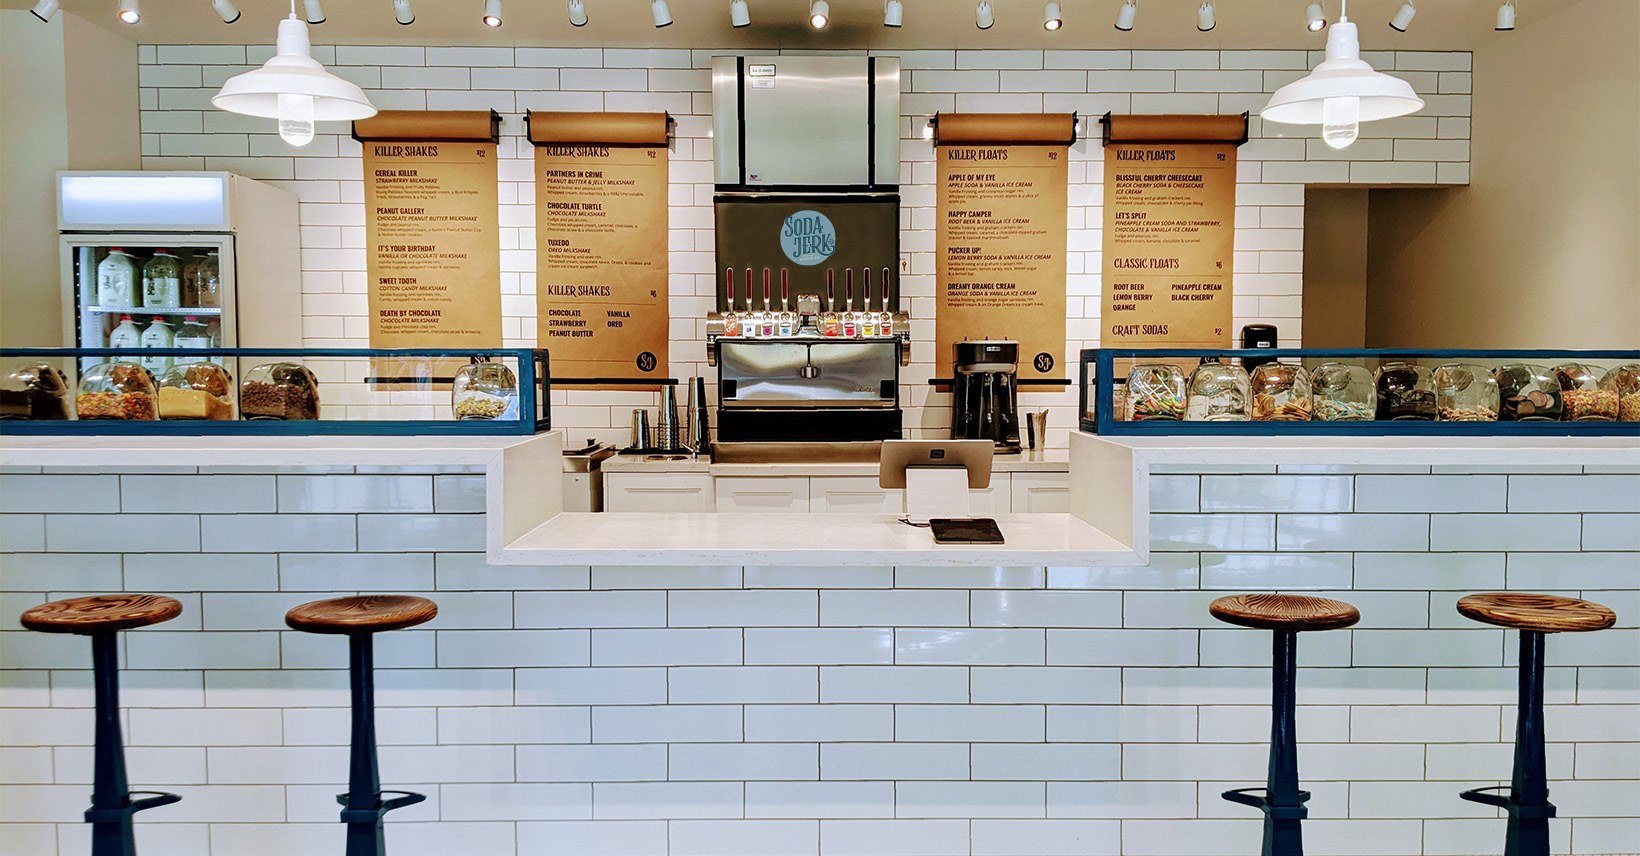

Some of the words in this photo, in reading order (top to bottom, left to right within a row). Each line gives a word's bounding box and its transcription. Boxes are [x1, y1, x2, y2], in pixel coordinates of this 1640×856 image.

[374, 146, 404, 158] KILLER
[405, 146, 438, 157] SHAKES
[546, 147, 575, 158] KILLER
[577, 148, 609, 158] SHAKES
[949, 150, 977, 162] KILLER
[978, 149, 1008, 160] FLOATS
[1116, 150, 1146, 163] KILLER
[1146, 150, 1176, 161] FLOATS
[785, 216, 823, 237] SODA
[793, 234, 835, 258] JERK
[1114, 258, 1148, 269] CLASSIC
[1150, 258, 1179, 269] FLOATS
[548, 285, 577, 297] KILLER
[578, 286, 610, 296] SHAKES
[1112, 325, 1140, 336] CRAFT
[1142, 325, 1168, 335] SODAS
